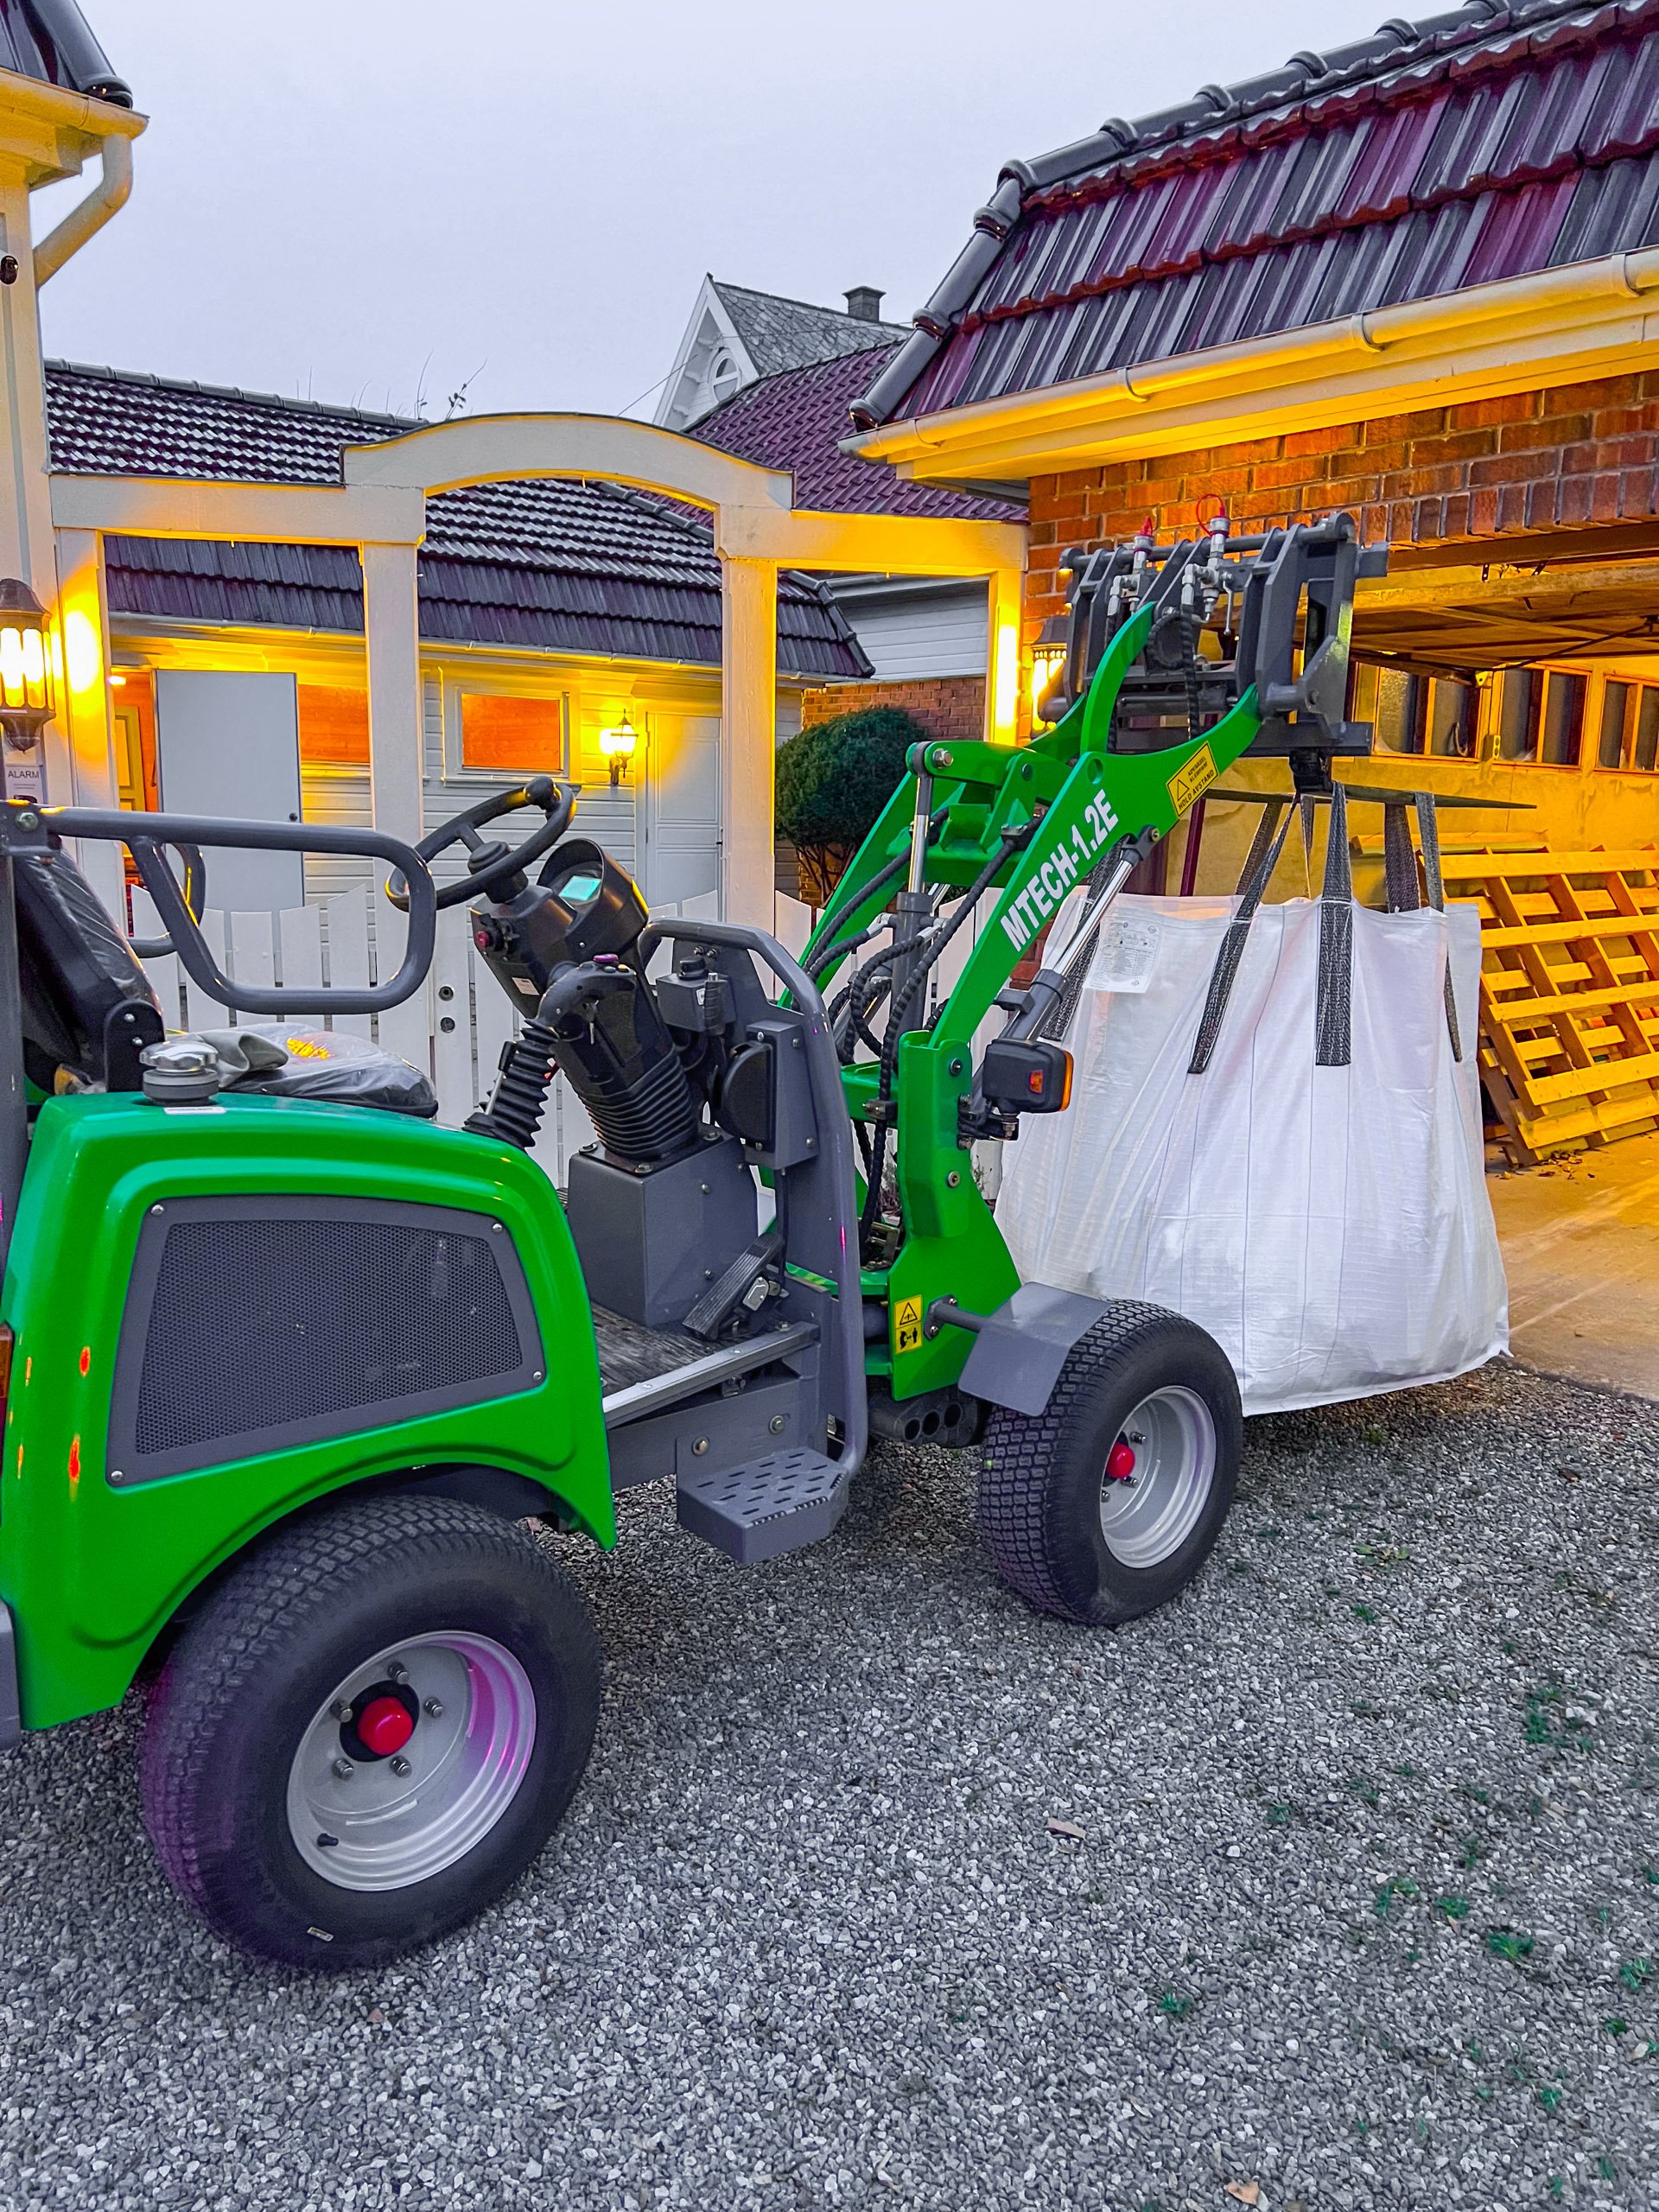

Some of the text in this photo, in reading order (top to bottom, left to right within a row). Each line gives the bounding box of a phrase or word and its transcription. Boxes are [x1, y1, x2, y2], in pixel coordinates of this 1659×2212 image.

[8, 770, 39, 779] ALARM
[1179, 770, 1214, 810] HOLD AVSTAND
[1000, 788, 1119, 952] MTECH-1.2E
